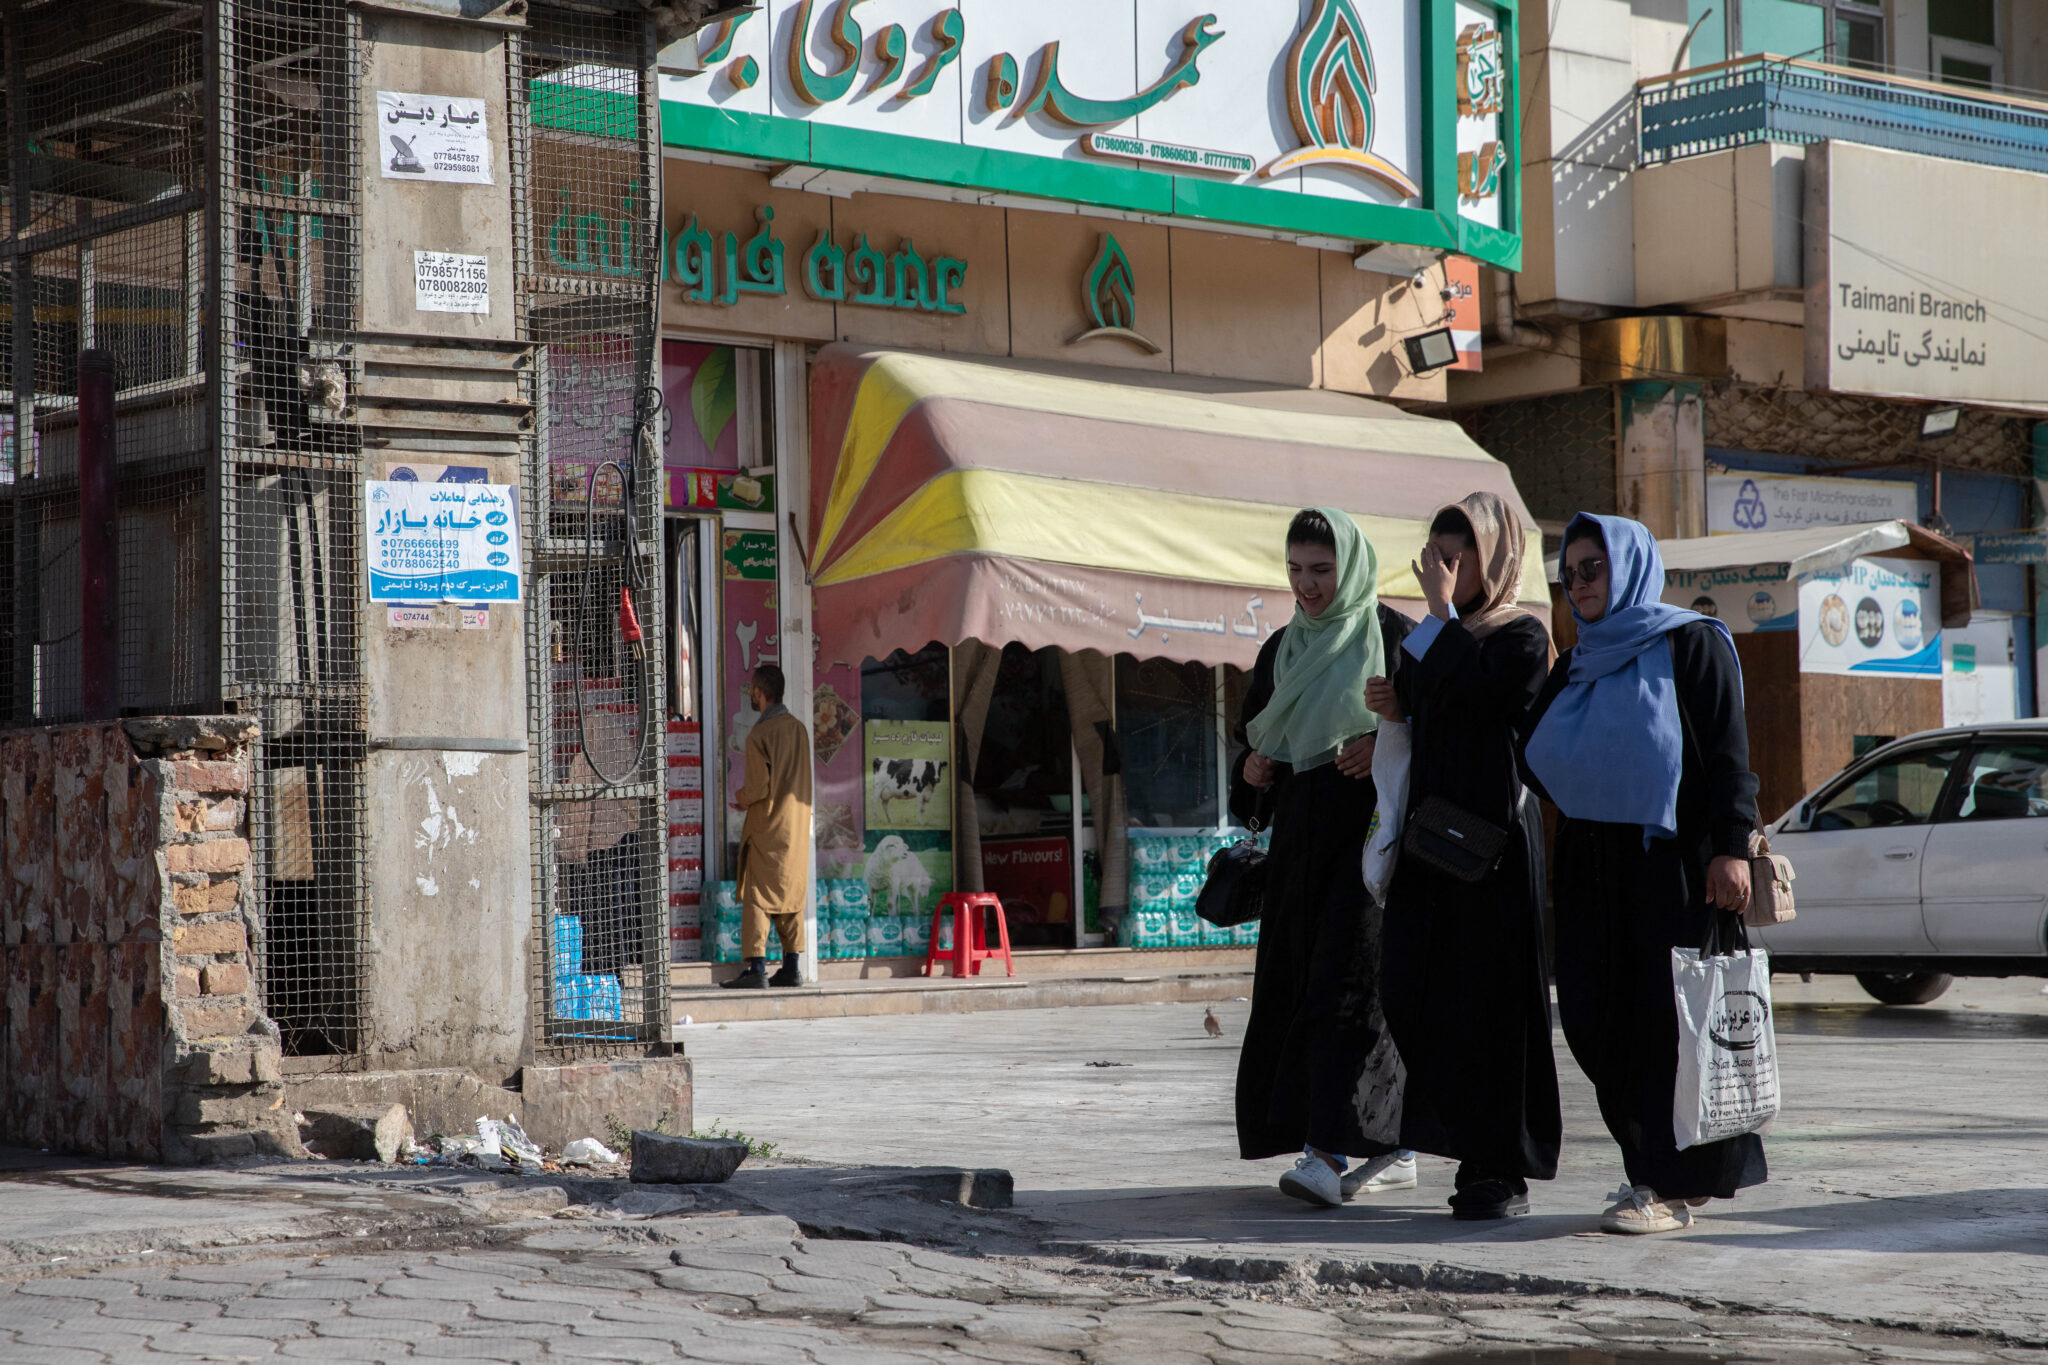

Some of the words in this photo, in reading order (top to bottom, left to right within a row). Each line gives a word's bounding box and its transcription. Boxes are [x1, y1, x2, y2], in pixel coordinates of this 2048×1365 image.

[987, 13, 1225, 125] عمده
[388, 101, 434, 125] دیش
[440, 104, 479, 129] عیار
[1095, 136, 1144, 155] 0798000260
[1151, 143, 1198, 163] 0788606030
[434, 152, 480, 162] 0778457857
[434, 162, 480, 173] 0729598081
[418, 252, 435, 264] دیش
[438, 254, 454, 265] عیار
[467, 257, 486, 267] نصب
[419, 265, 486, 280] 0798571156
[806, 230, 967, 314] عمده
[419, 279, 488, 294] 0780082802
[1839, 283, 1914, 315] Taimani
[1920, 292, 1986, 323] Branch
[1838, 329, 1901, 364] تایمنی
[1904, 329, 1985, 371] نمایندگی
[430, 491, 466, 502] معاملات
[468, 493, 505, 506] رهنمایی
[376, 508, 428, 534] بازار
[433, 509, 482, 529] خانه
[390, 539, 459, 549] 0766666699
[390, 549, 459, 559] 0774843479
[391, 558, 460, 569] 0788062540
[381, 581, 412, 592] تایمنی
[414, 580, 438, 593] پروژه
[441, 582, 454, 592] دوم
[457, 581, 481, 593] سرک
[1127, 591, 1226, 643] سبز
[984, 850, 1008, 865] New
[1011, 847, 1063, 865] Flavours!
